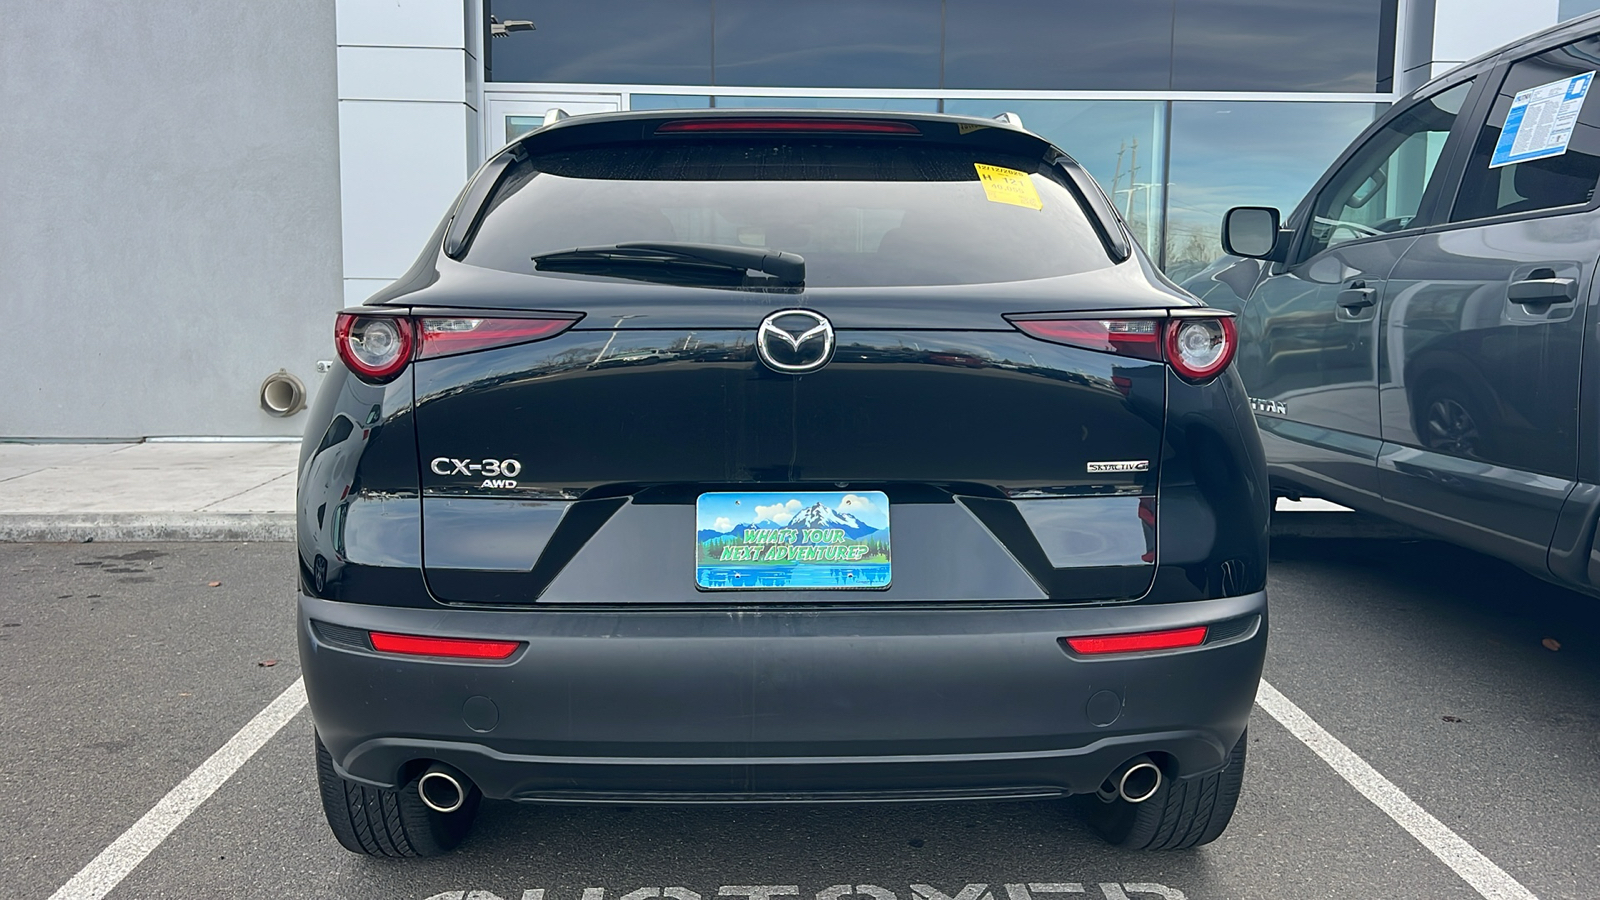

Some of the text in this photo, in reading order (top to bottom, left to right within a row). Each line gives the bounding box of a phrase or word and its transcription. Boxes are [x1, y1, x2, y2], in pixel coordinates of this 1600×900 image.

[982, 173, 993, 182] H
[1001, 177, 1024, 187] 121
[430, 457, 522, 477] CX-30
[480, 479, 518, 489] AWD
[743, 528, 846, 544] WHAT'S YOUR
[719, 545, 870, 562] NEXT ADVENTURE?
